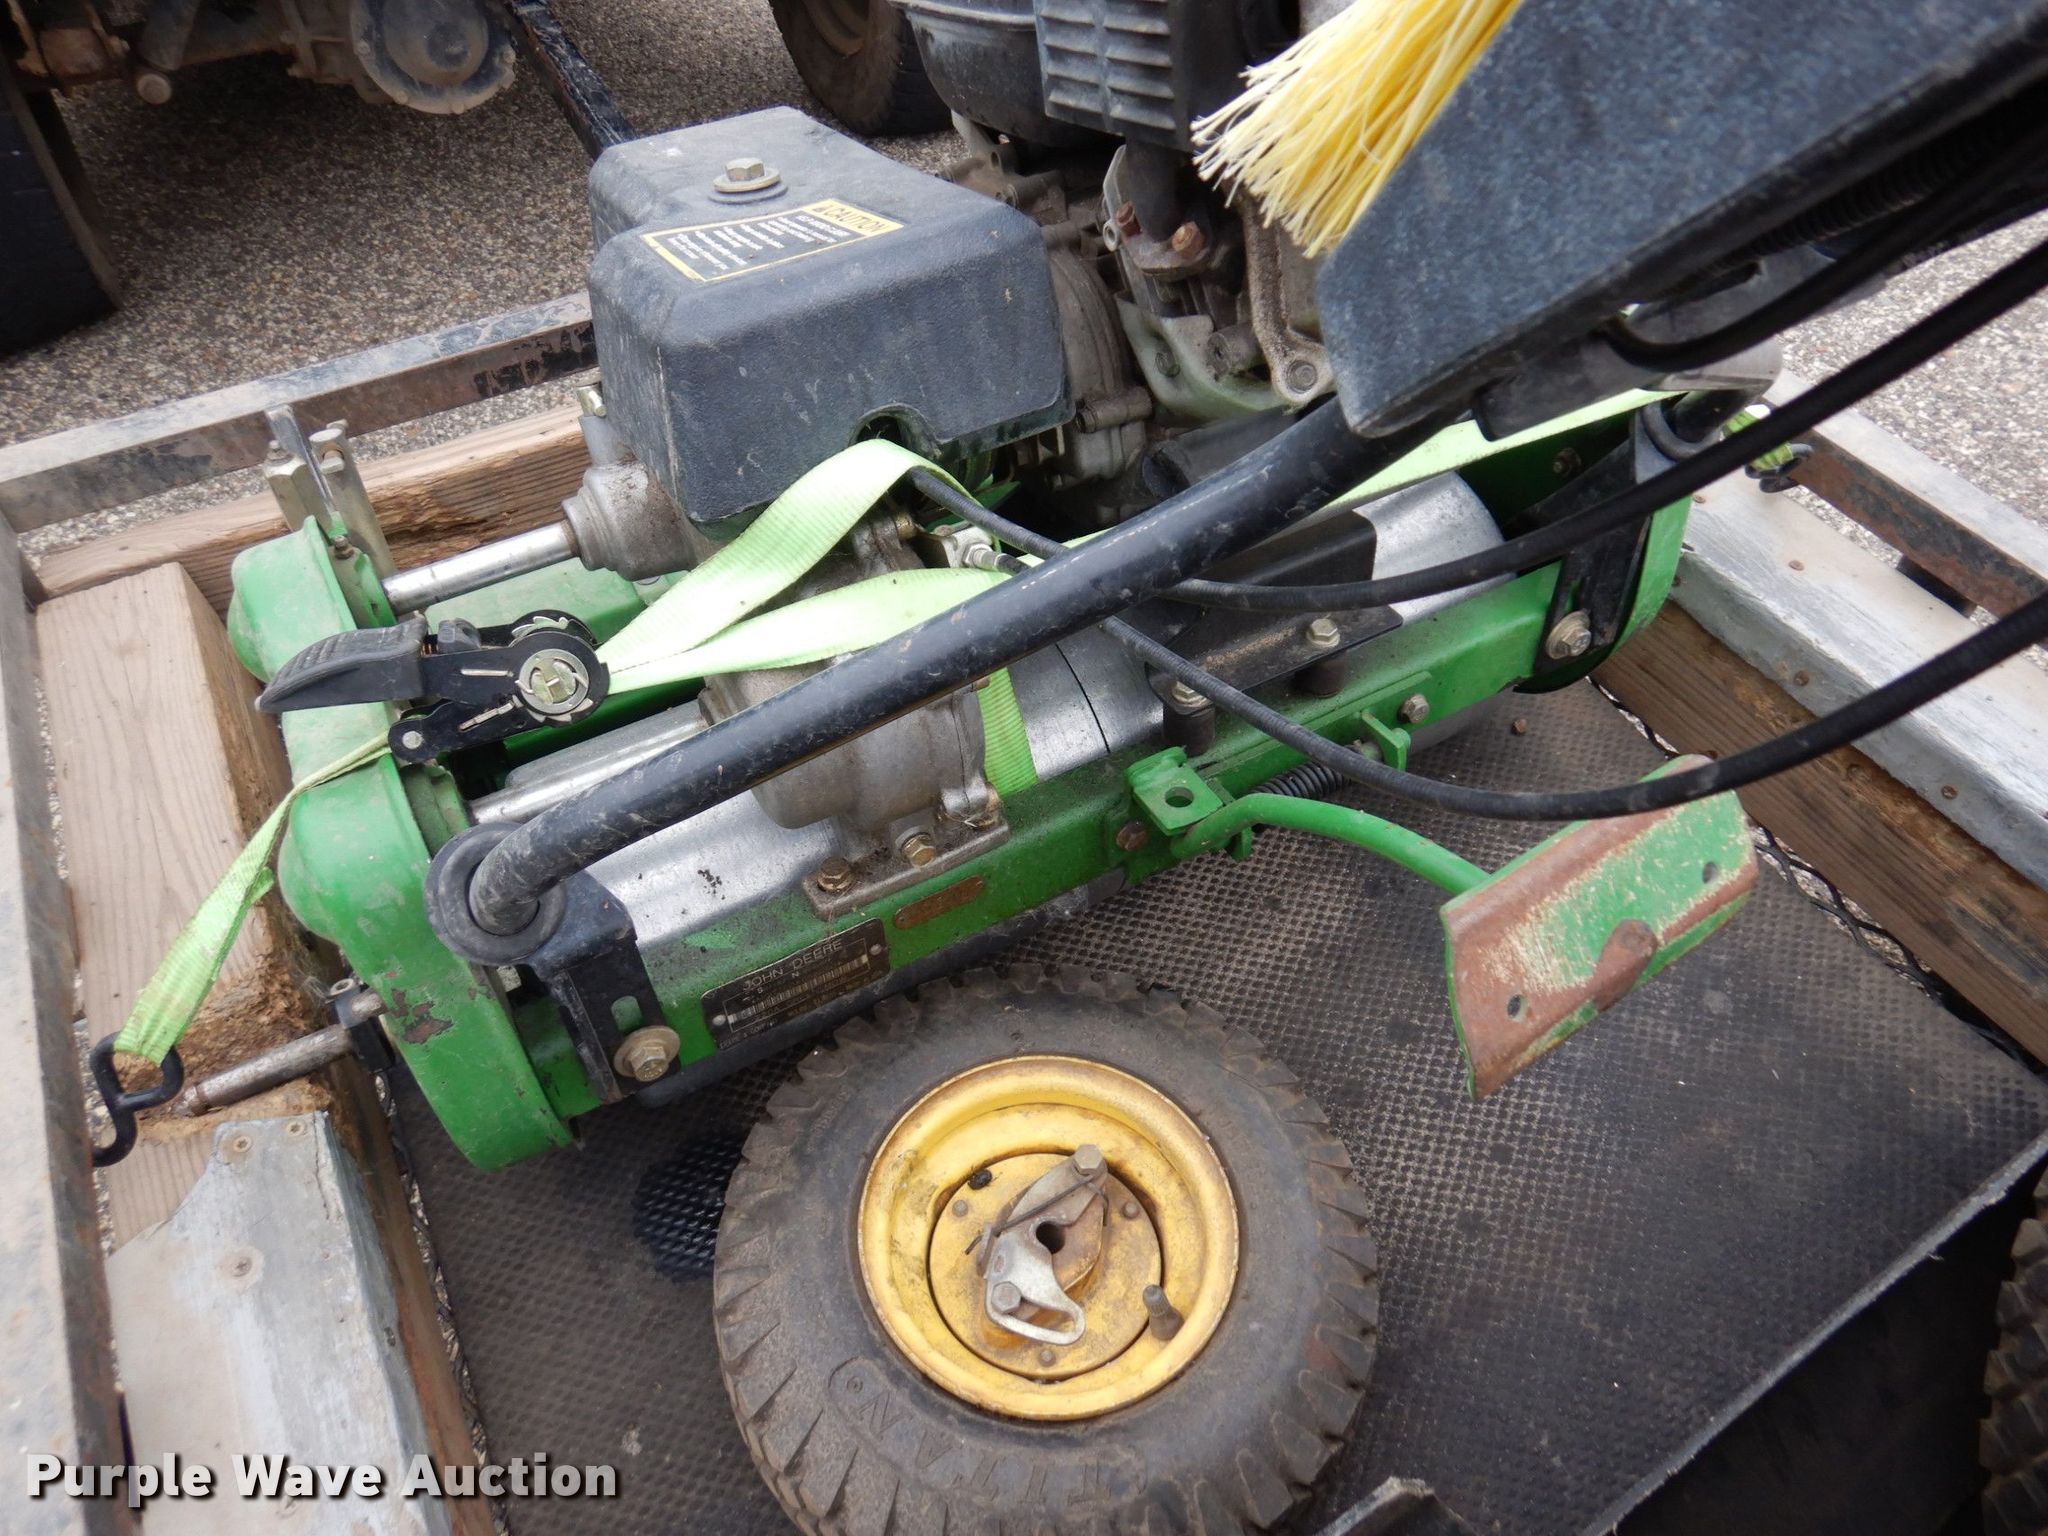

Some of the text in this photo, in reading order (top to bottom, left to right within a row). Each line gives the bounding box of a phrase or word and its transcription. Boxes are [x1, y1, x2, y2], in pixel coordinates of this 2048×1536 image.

[824, 204, 886, 232] CAUTION
[742, 940, 843, 992] JOHN DEERE
